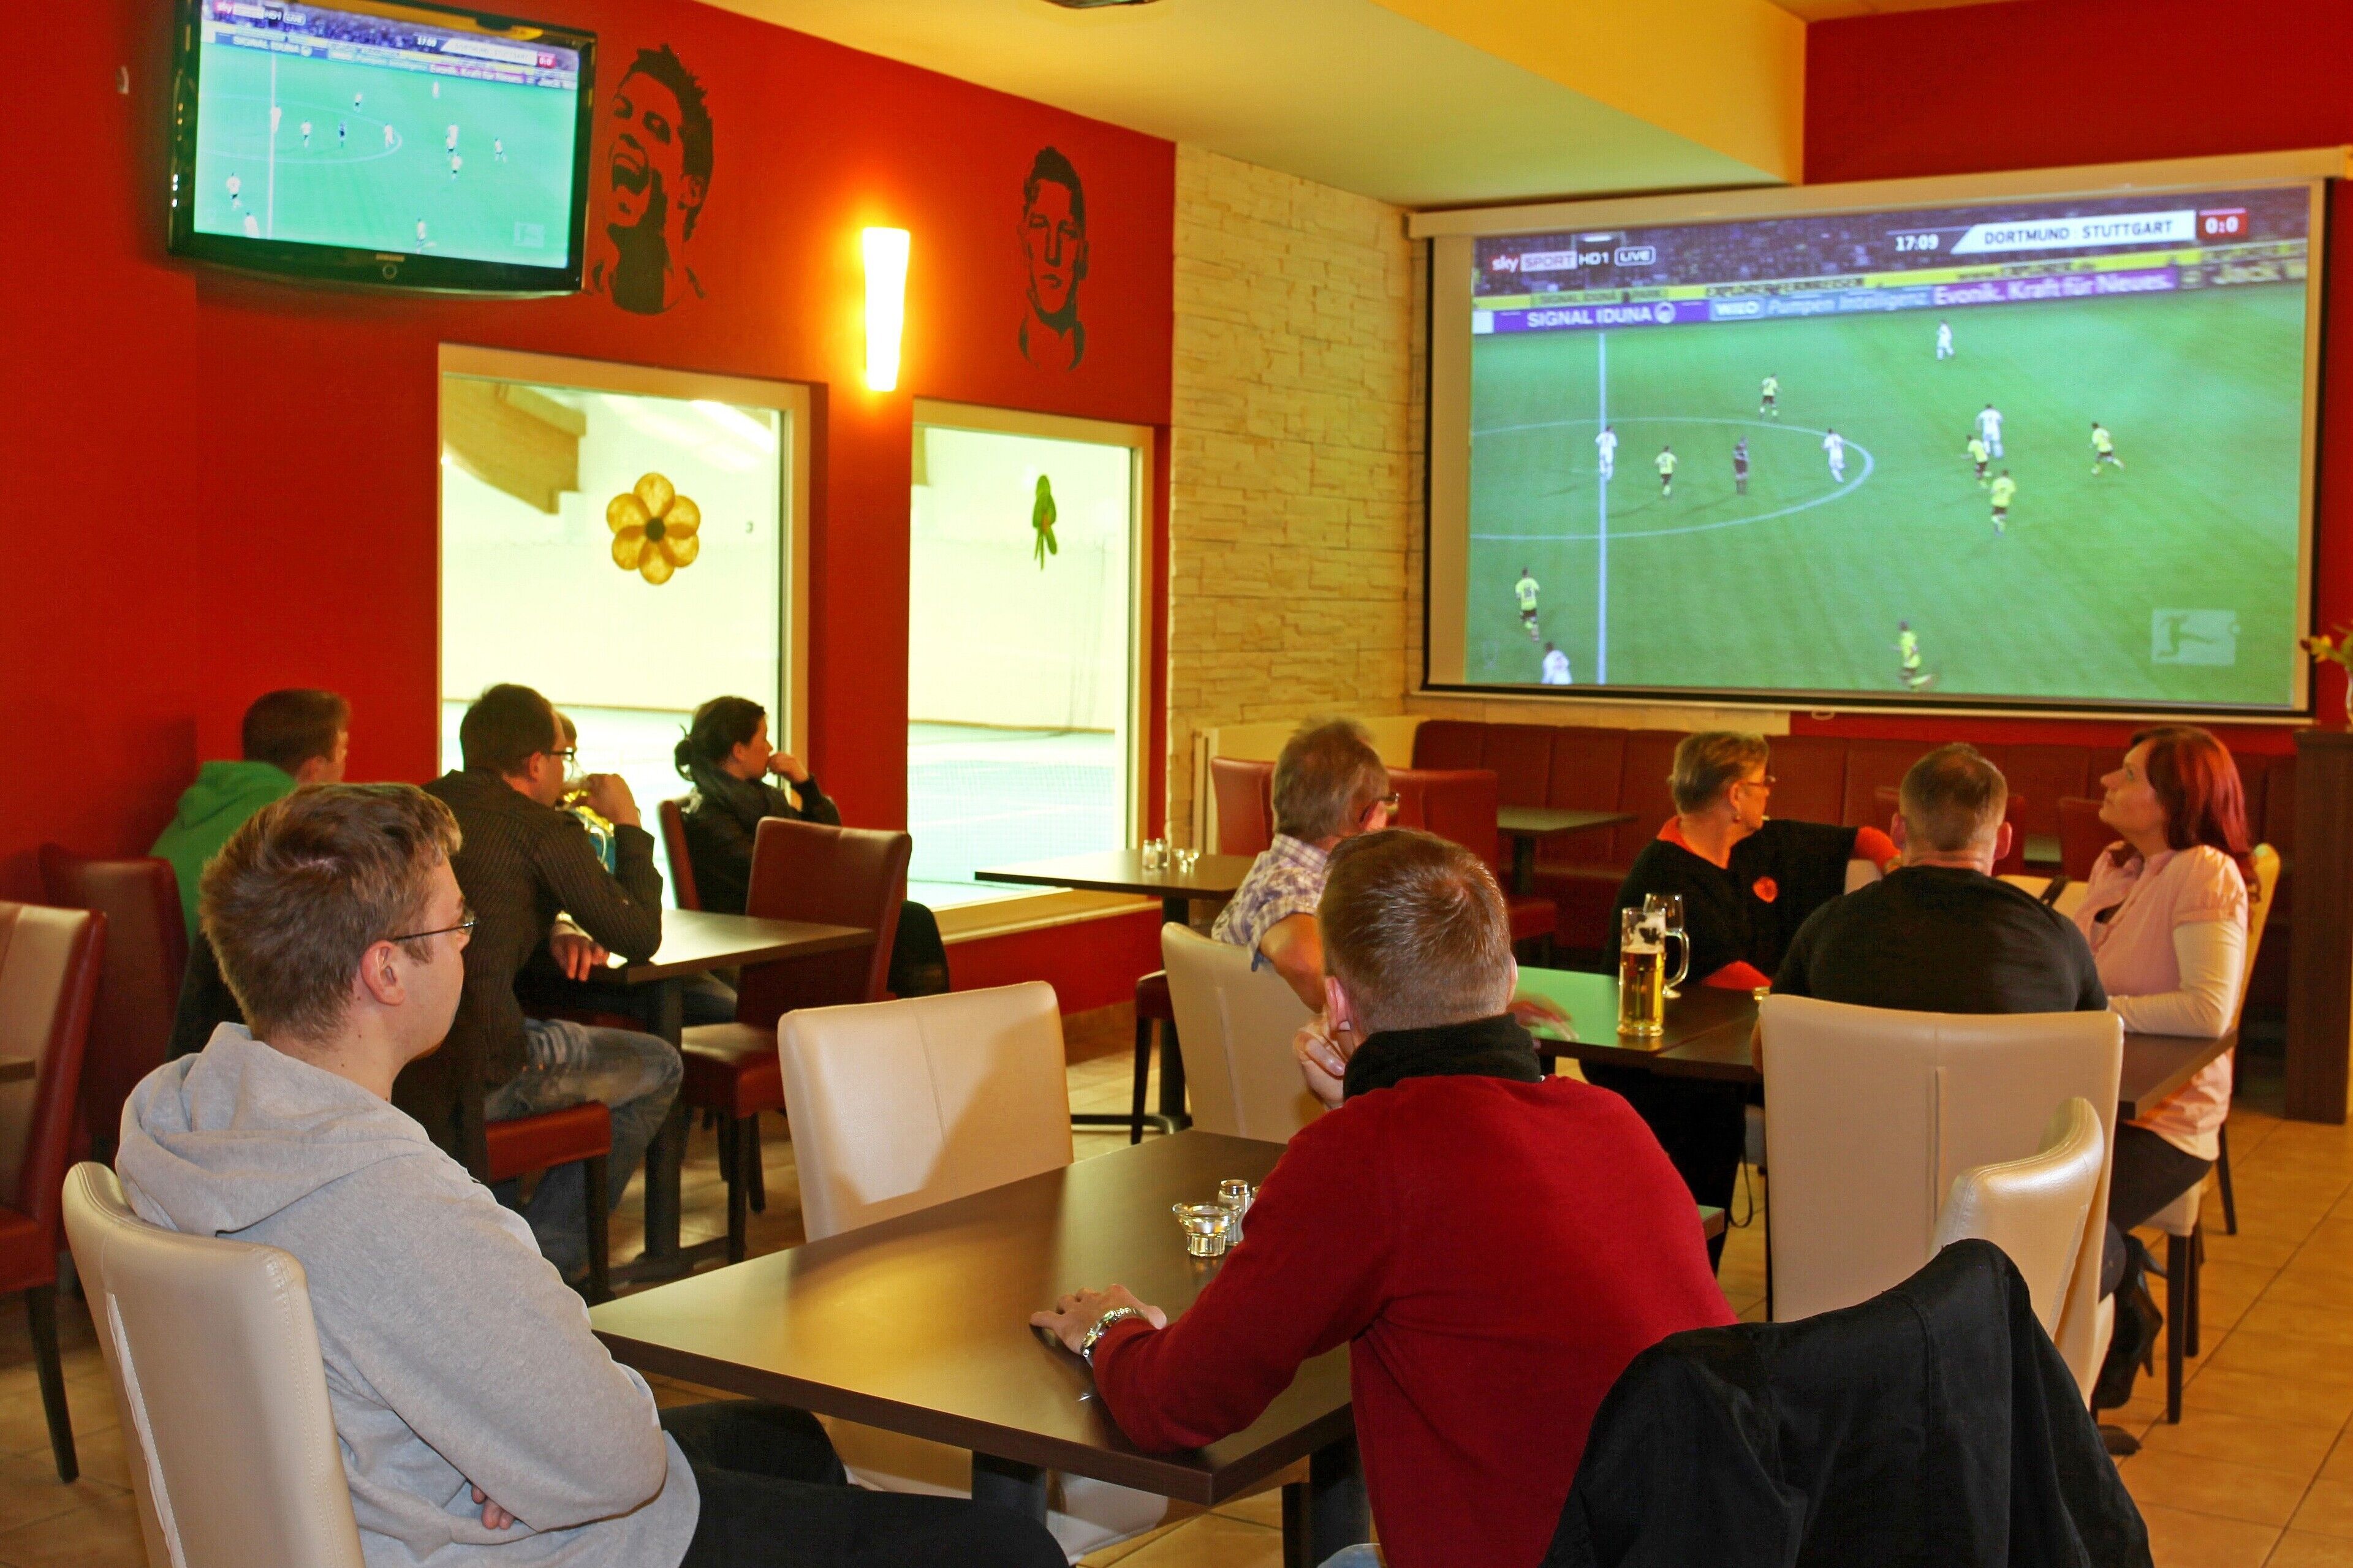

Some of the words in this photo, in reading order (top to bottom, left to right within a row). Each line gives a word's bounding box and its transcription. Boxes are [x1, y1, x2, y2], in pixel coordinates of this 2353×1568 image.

[1985, 227, 2069, 244] DORTMUND
[2082, 221, 2173, 240] STUTTGART
[2205, 216, 2239, 235] 0:0
[1895, 234, 1939, 252] 17:09
[1492, 255, 1518, 273] sky
[1525, 254, 1575, 270] SPORT
[1578, 252, 1608, 265] HD1
[1620, 250, 1651, 262] LIVE
[1934, 282, 2006, 305] Evonik.
[2007, 277, 2061, 299] Kraft
[2062, 276, 2094, 296] für
[1527, 310, 1593, 328] SIGNAL
[1595, 307, 1653, 324] IDUNA
